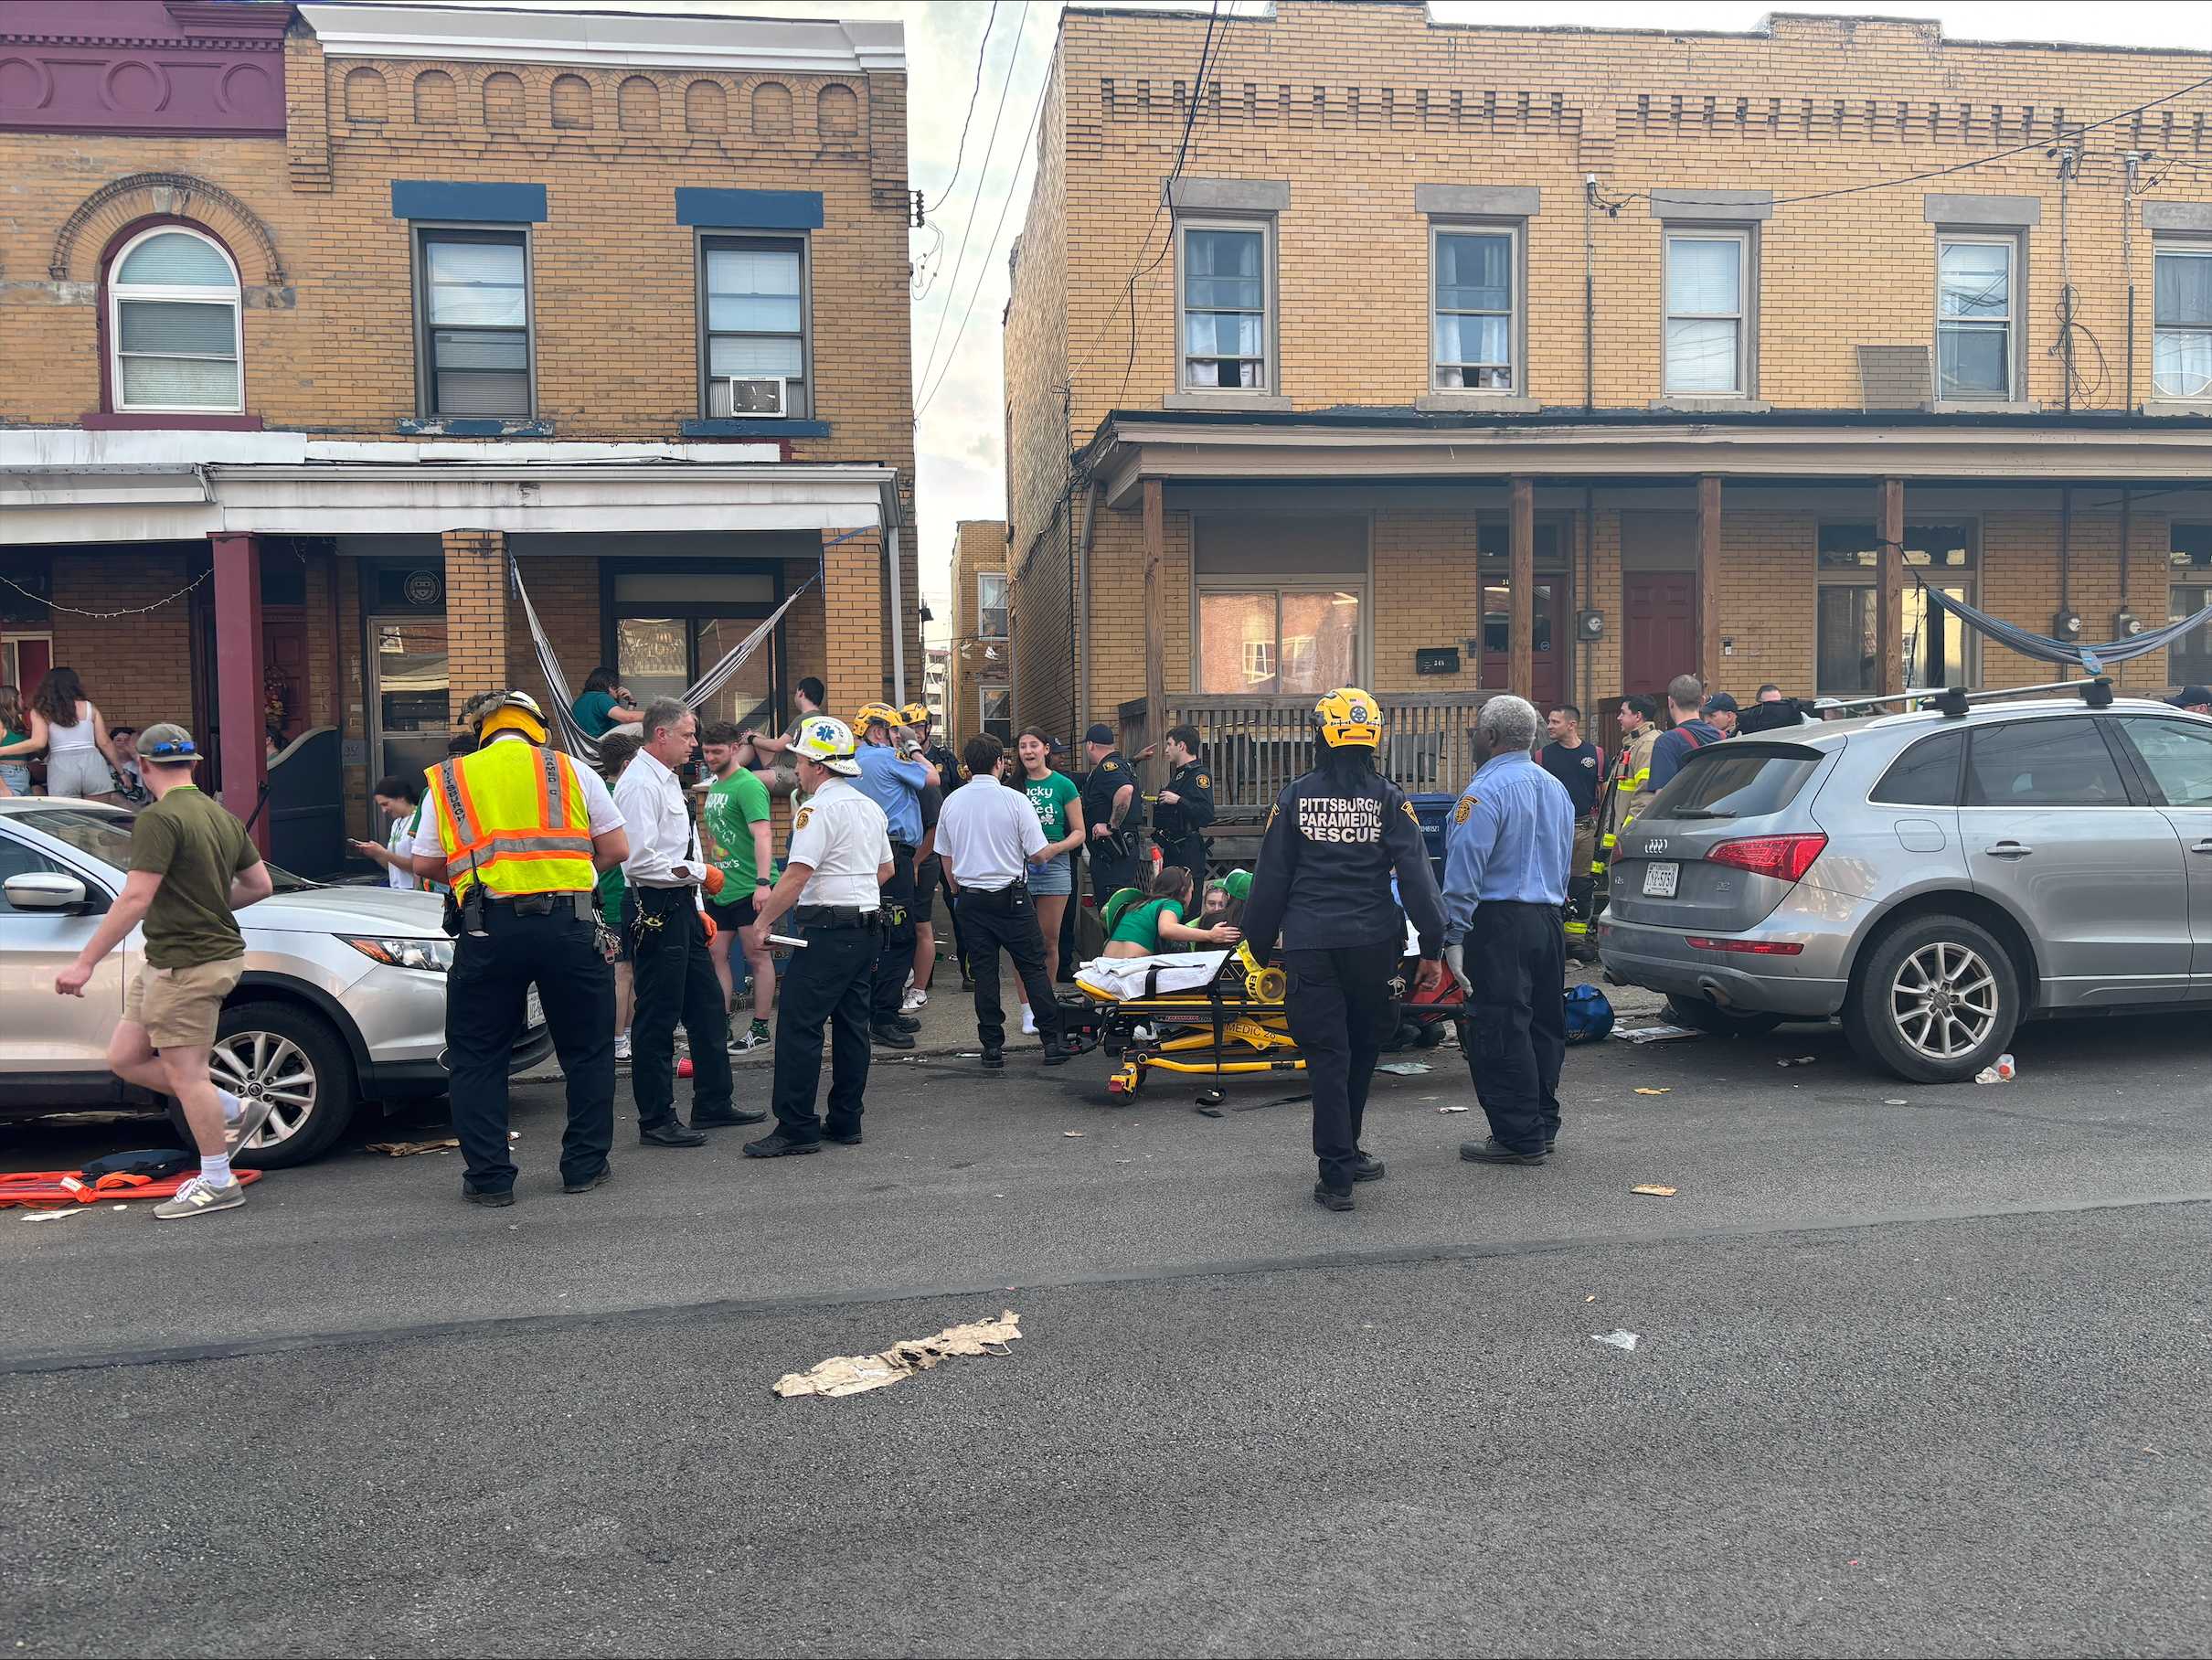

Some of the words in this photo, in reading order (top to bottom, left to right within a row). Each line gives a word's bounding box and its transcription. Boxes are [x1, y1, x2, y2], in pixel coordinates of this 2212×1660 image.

[1026, 786, 1053, 798] ucky
[1031, 796, 1041, 805] &
[1299, 798, 1382, 815] PITTSBURGH
[1036, 803, 1058, 814] ed.
[1299, 813, 1382, 828] PARAMEDIC
[1300, 827, 1382, 843] RESCUE
[1226, 1023, 1260, 1036] MEDIC
